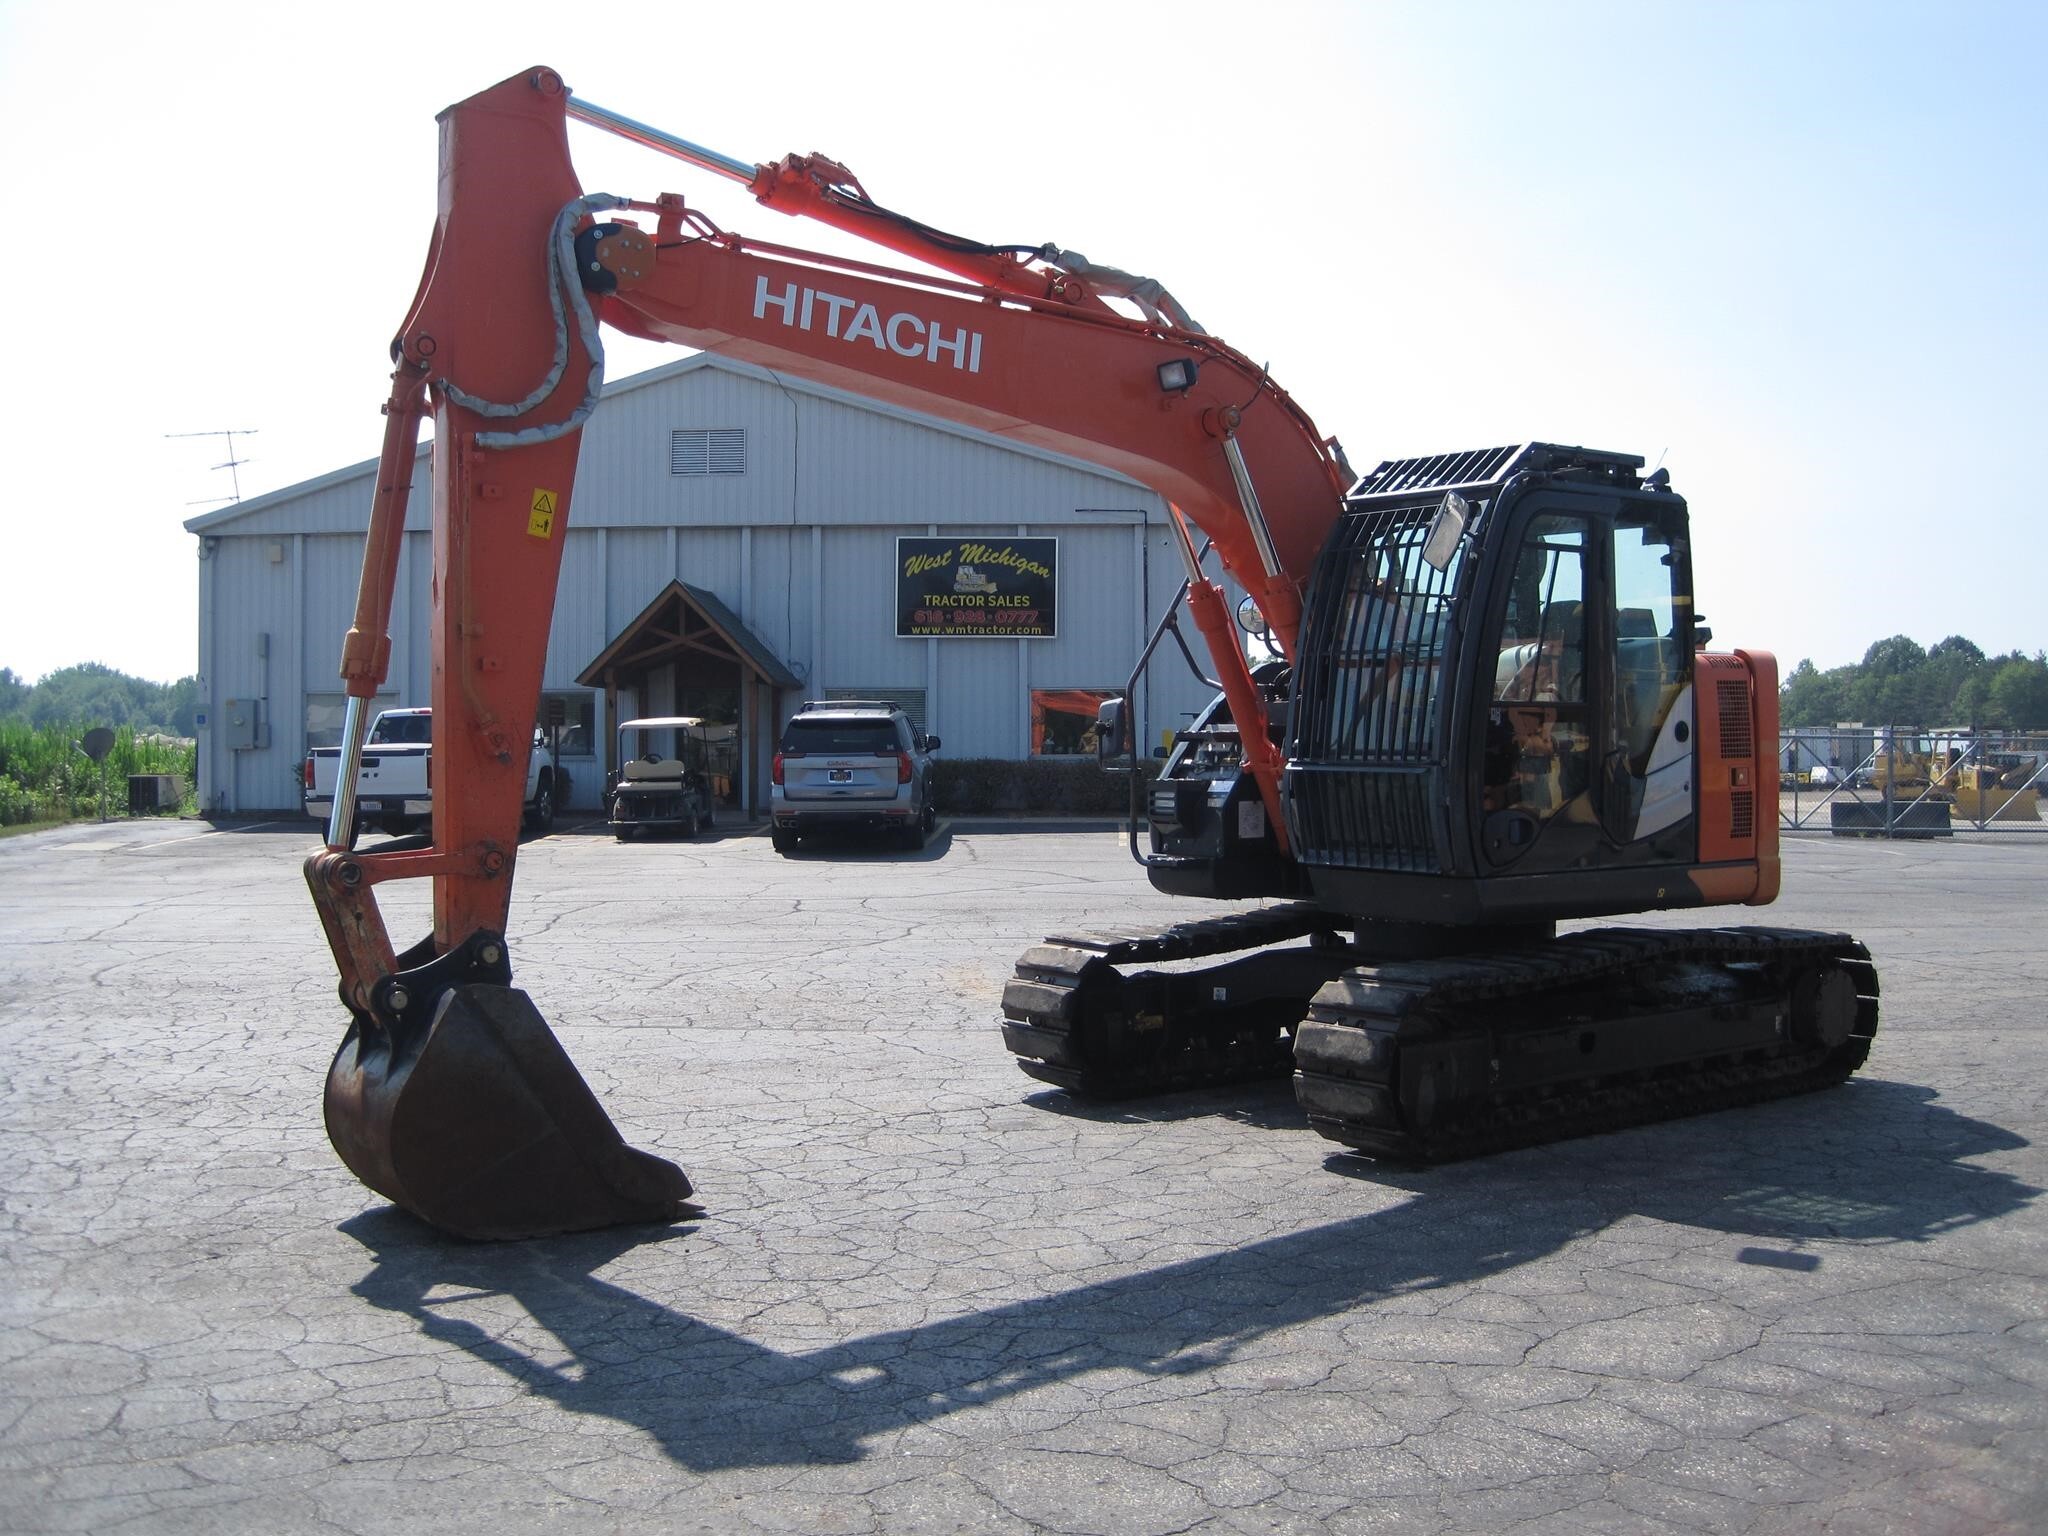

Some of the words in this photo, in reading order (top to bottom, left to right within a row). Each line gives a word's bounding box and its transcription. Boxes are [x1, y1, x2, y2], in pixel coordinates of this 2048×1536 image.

[753, 275, 983, 373] HITACHI
[904, 550, 952, 577] West
[960, 543, 1050, 578] Michigan
[924, 595, 985, 607] TRACTOR
[988, 595, 1030, 607] SALES
[911, 625, 1042, 635] www.wmtractor.com
